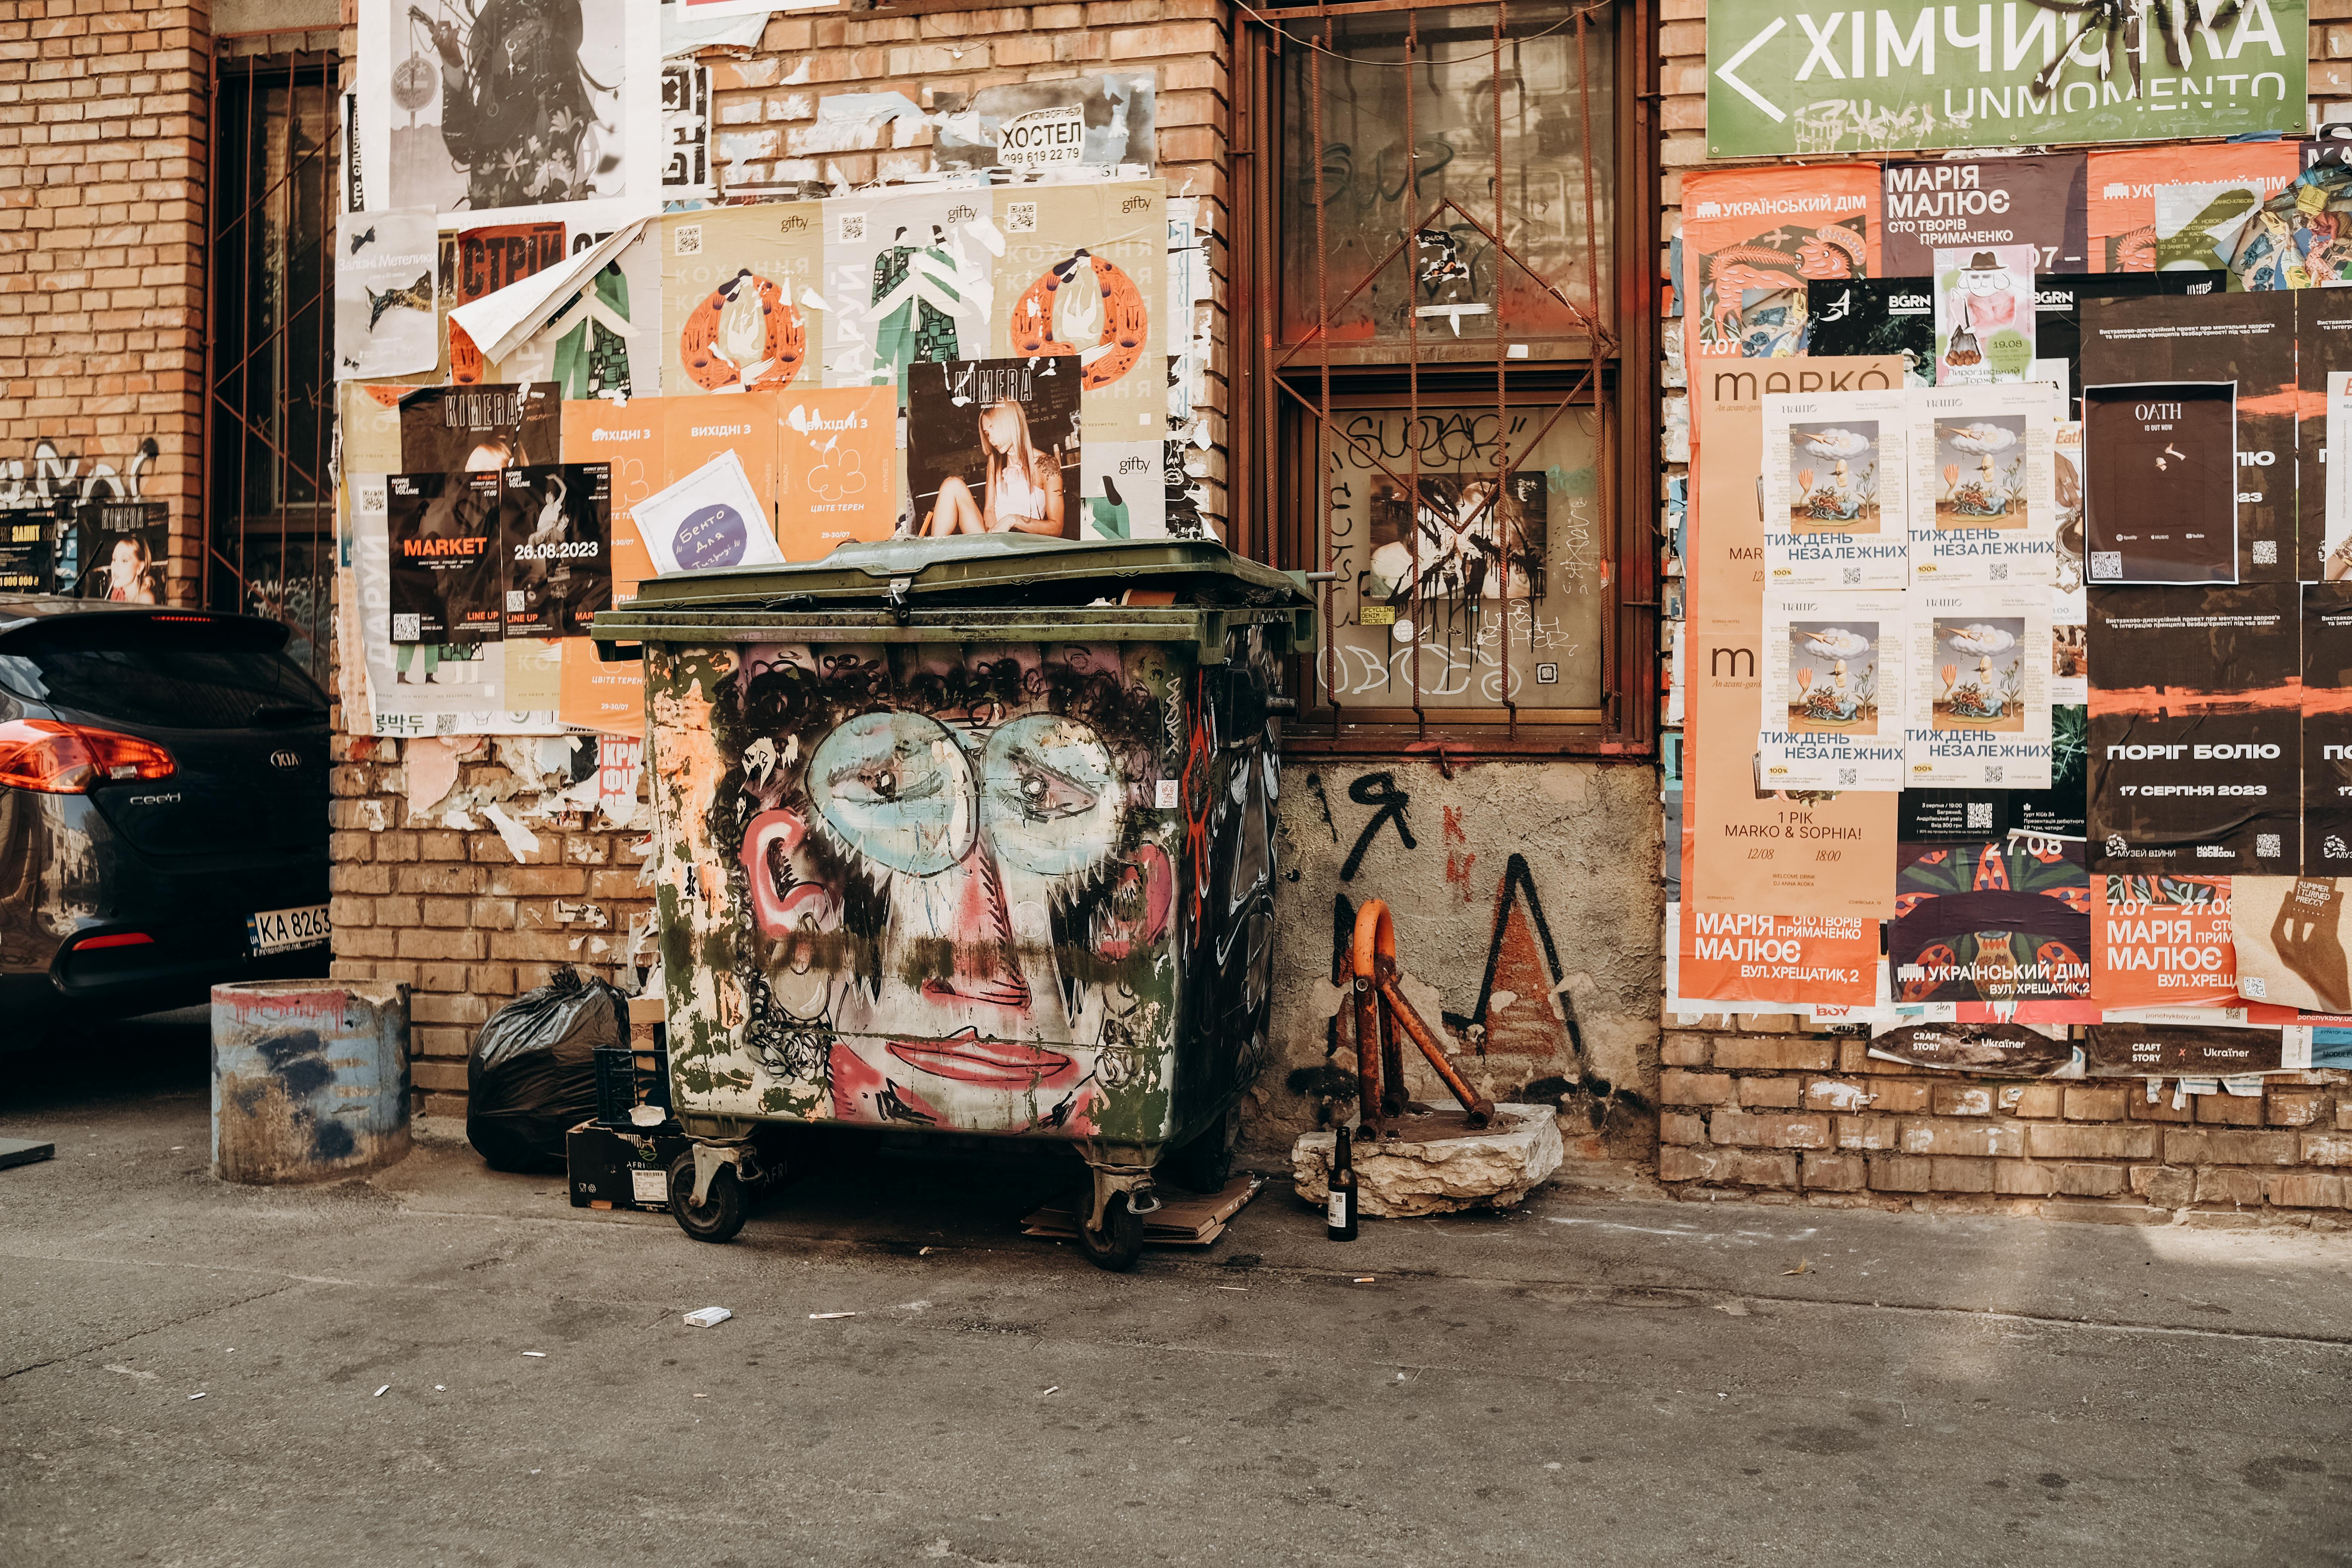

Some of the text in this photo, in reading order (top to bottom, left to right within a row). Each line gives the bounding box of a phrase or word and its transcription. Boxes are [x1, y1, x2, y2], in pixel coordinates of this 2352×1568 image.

[1793, 0, 2286, 82] ХІМЧИСКА
[1943, 72, 2286, 121] UNMOMENTO
[1002, 121, 1081, 150] ХОСТЕЛ
[1027, 147, 1079, 163] 619 22 79
[1888, 165, 1980, 193] МАРІЯ
[2309, 187, 2319, 204] Glovo
[1122, 195, 1152, 214] gifty
[1723, 194, 1867, 217] УКРАЇНСЬКИЙ ДІМ
[1888, 189, 2011, 219] МАЛЮЄ
[947, 205, 978, 223] gifty
[781, 215, 809, 233] gifty
[1888, 219, 1967, 233] СТО ТВОРІВ
[1424, 234, 1445, 243] 04/06
[1920, 229, 2014, 245] ПРИМАЧЕНКО
[337, 253, 436, 272] Залізні Метелики
[462, 225, 561, 297] СТРІЙ
[1889, 295, 1931, 309] BGRN
[1700, 338, 1740, 355] 7.07
[1993, 340, 2023, 349] 19.08
[1947, 367, 2020, 377] Пирогівський
[954, 368, 1033, 404] KIMERA
[445, 392, 518, 427] KIMERA
[2135, 403, 2182, 421] OATH
[691, 425, 741, 437] ВИХІДНІ
[807, 419, 856, 431] ВИХІДНІ
[592, 429, 640, 442] ВИХІДНІ
[1119, 455, 1151, 475] gifty
[810, 502, 864, 513] ЦВІТЕ ТЕРЕН
[102, 506, 144, 530] KIMERA
[12, 524, 40, 542] ЗАПИТ
[679, 510, 725, 545] Бенто
[696, 532, 725, 554] Для
[821, 531, 850, 540] 29-30/07
[1764, 533, 1853, 547] ТИЖДЕНЬ
[1910, 528, 2000, 543] ТИЖДЕНЬ
[404, 537, 487, 557] MARKET
[514, 541, 599, 560] 26.08.2023
[1788, 545, 1908, 560] НЕЗАЛЕЖНИХ
[1934, 541, 2055, 556] НЕЗАЛЕЖНИХ
[467, 611, 499, 621] LINE UP
[507, 613, 538, 623] LINE UP
[592, 676, 615, 685] ЦВІТЕ
[1761, 732, 1850, 746] ТИЖДЕНЬ
[1905, 729, 1996, 744] ТИЖДЕНЬ
[1785, 746, 1904, 761] НЕЗАЛЕЖНИХ
[1930, 744, 2051, 758] НЕЗАЛЕЖНИХ
[2107, 744, 2280, 760] ПОРІГ БОЛЮ
[275, 752, 299, 767] KIA
[2119, 785, 2267, 796] 17 СЕРПНЯ 2023
[130, 792, 181, 805] cee'd
[1778, 812, 1784, 823] 1
[1725, 824, 1862, 840] MARKO & SOPHIA!
[1747, 848, 1841, 862] 12/08 18:00
[2117, 848, 2176, 858] МУЗЕЙ ВІЙНИ
[2299, 880, 2329, 893] SUMMER
[2301, 888, 2331, 901] TURNED
[2107, 898, 2147, 916] 7.07
[291, 908, 332, 938] 8263
[1696, 912, 1774, 936] МАРІЯ
[1777, 925, 1862, 940] ПРИМАЧЕНКО
[2107, 920, 2191, 944] МАРІЯ
[250, 935, 259, 945] UA
[1695, 937, 1801, 963] МАЛЮЄ
[2107, 946, 2222, 971] МАЛЮЄ
[1741, 965, 1859, 984] ВУЛ. ХРЕЩАТИК, 2
[1928, 960, 2090, 981] УКРАЇНСЬКИЙ ДІМ
[2158, 974, 2189, 988] ВУЛ.
[1989, 983, 2014, 995] ВУЛ.
[2145, 1012, 2200, 1021] ponchykboy.ua
[1913, 1032, 1941, 1041] CRAFT
[1913, 1042, 1940, 1051] STORY
[2132, 1043, 2161, 1052] CRAFT
[2132, 1054, 2161, 1063] STORY
